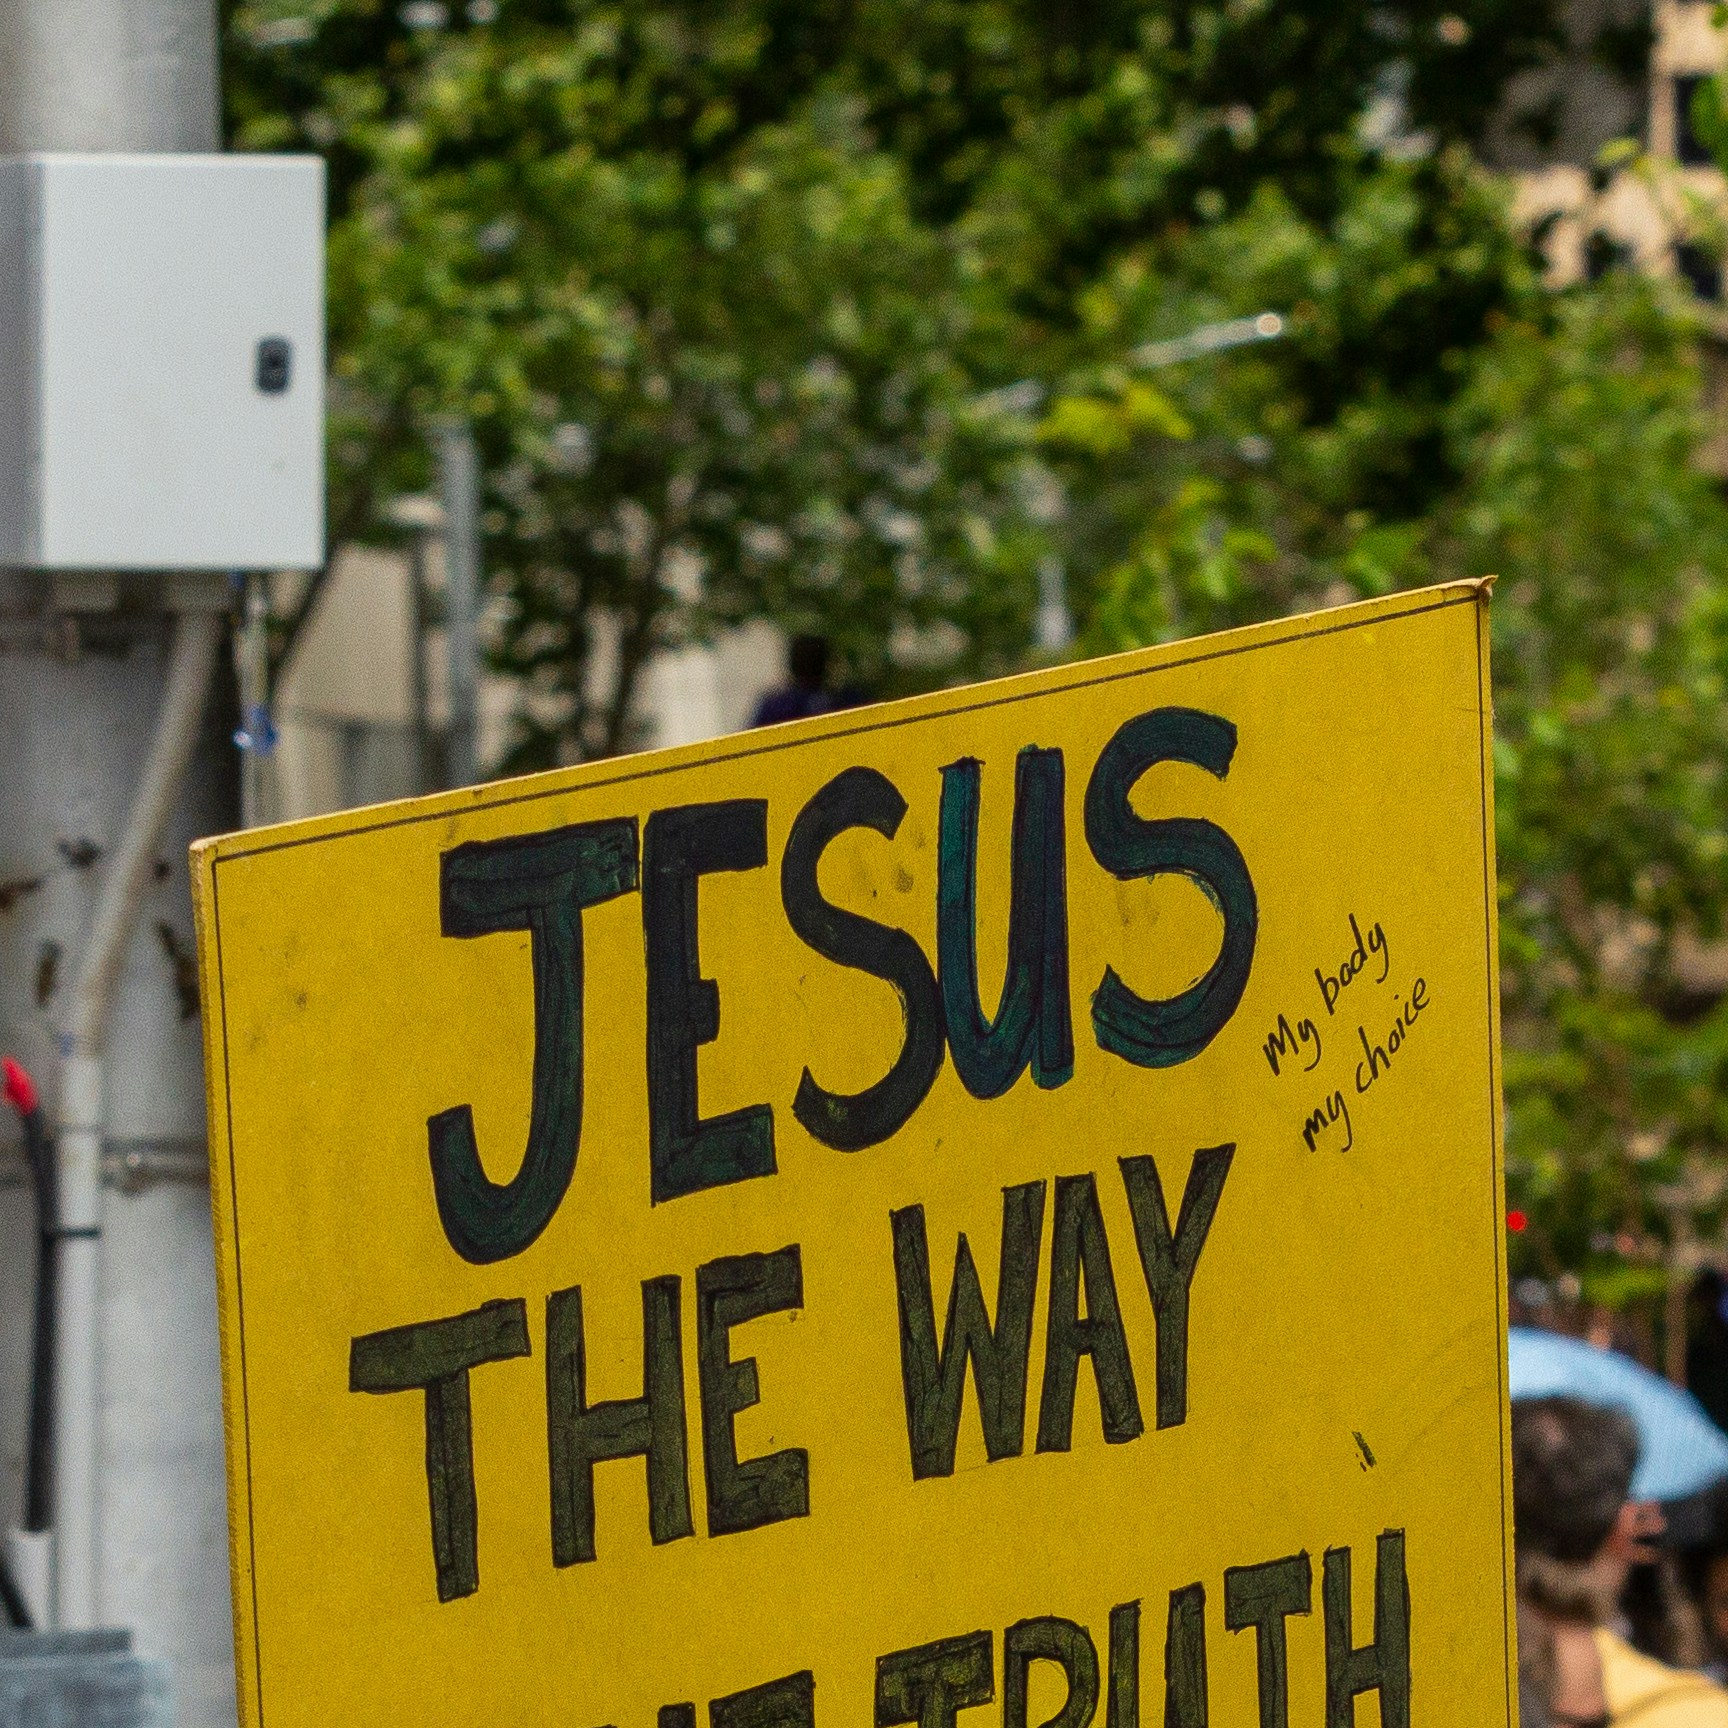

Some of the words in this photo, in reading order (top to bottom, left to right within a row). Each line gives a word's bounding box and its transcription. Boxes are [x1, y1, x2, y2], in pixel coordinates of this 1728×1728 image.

[427, 705, 1259, 1265] JESUS
[1262, 1013, 1323, 1077] My
[1313, 912, 1390, 1017] body
[1302, 1089, 1354, 1154] my
[1354, 977, 1431, 1094] choice
[348, 1243, 810, 1604] THE
[888, 1142, 1236, 1481] WAY
